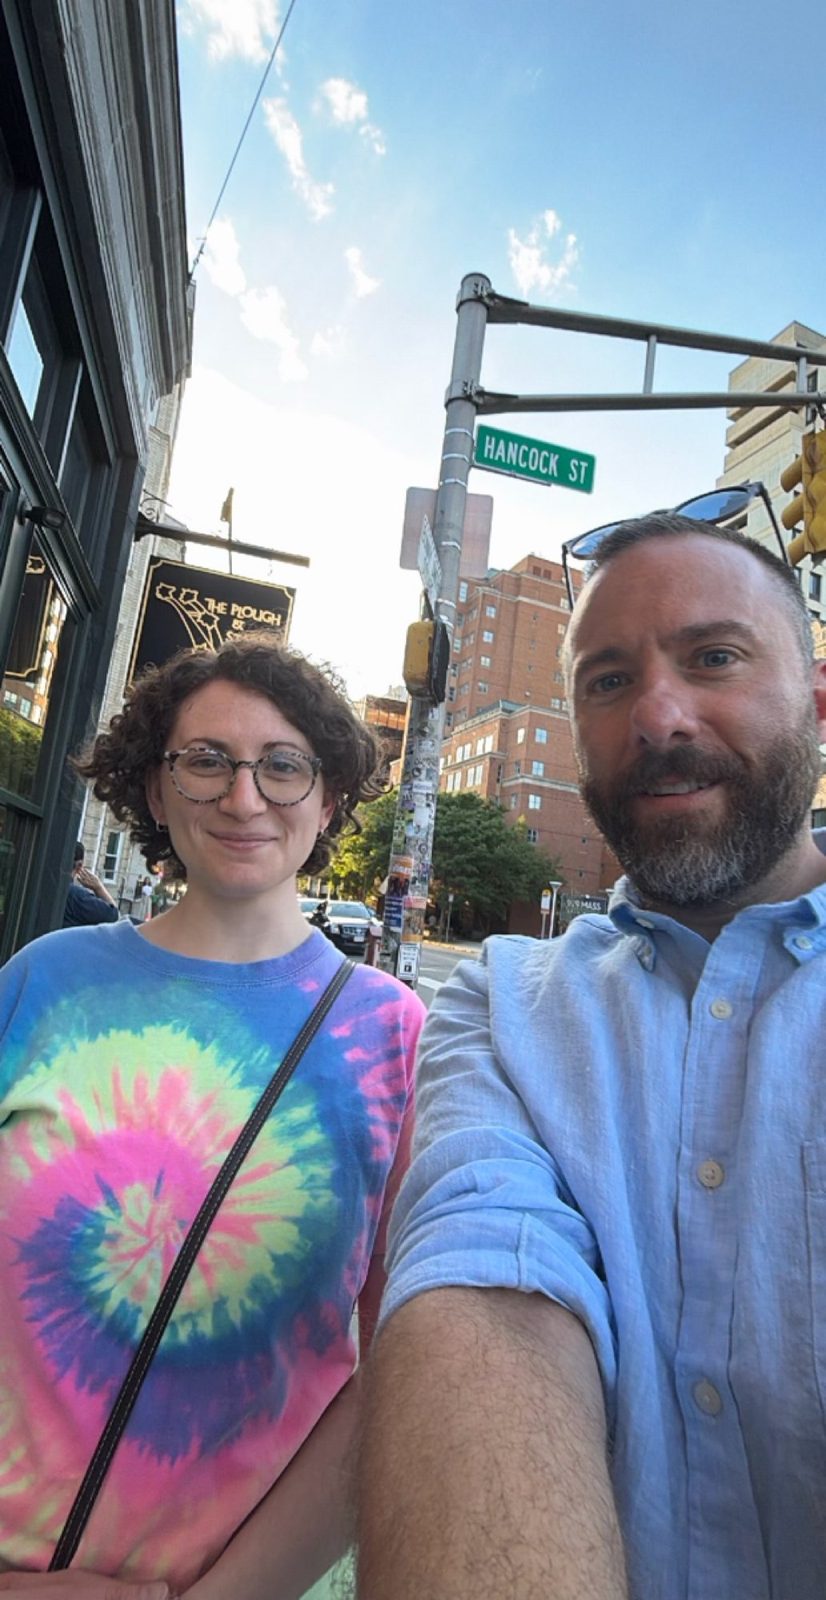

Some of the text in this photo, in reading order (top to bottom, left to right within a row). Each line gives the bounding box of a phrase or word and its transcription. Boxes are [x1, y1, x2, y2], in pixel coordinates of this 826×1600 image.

[483, 434, 589, 485] HANCOCK ST
[204, 597, 282, 627] THE PLOUGH
[231, 619, 246, 631] &
[580, 900, 602, 911] MASS
